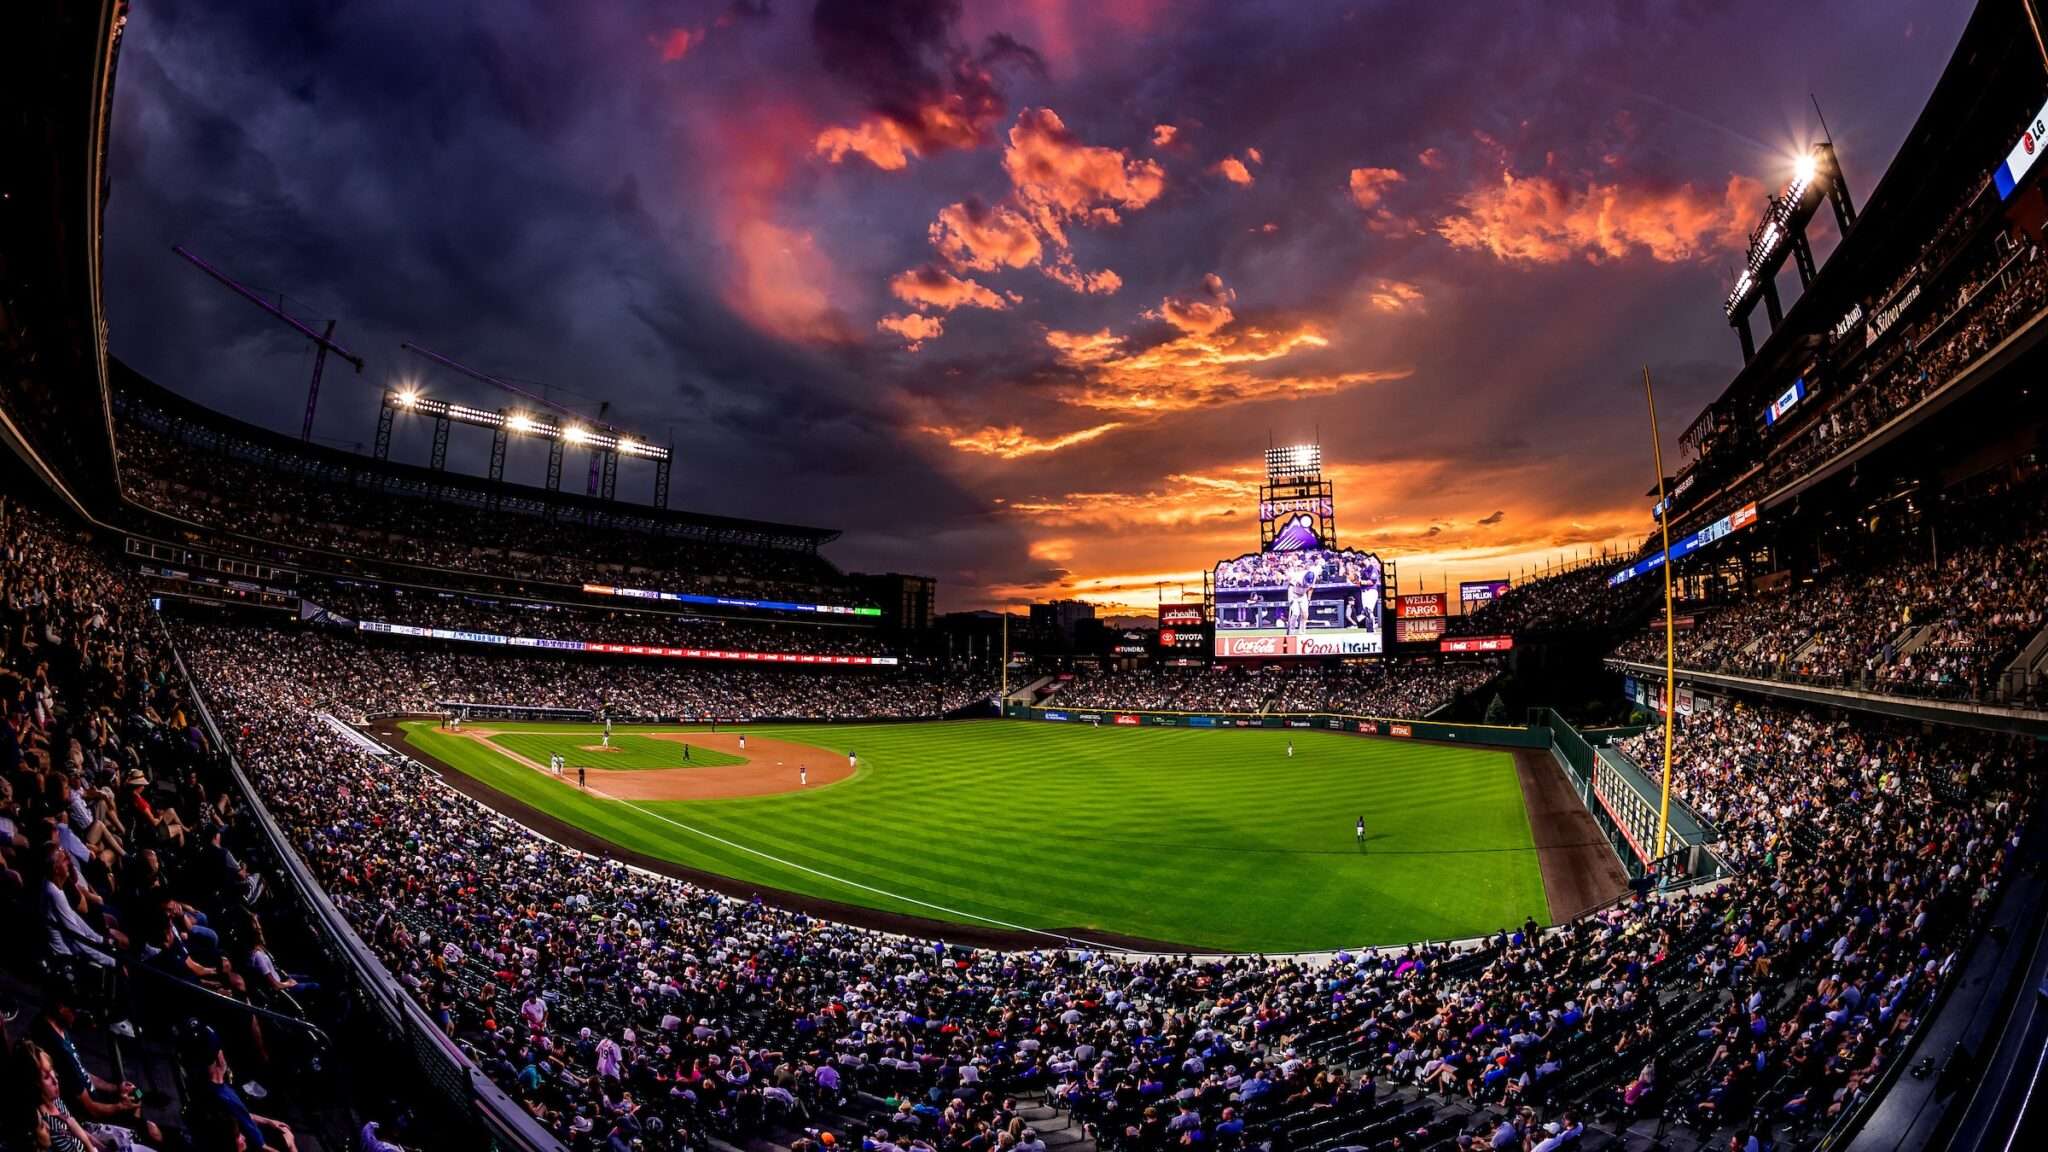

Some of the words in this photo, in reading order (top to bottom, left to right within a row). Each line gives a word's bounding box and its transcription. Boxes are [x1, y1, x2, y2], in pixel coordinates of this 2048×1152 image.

[2032, 119, 2046, 142] LG
[1405, 595, 1437, 605] WELLS
[1405, 605, 1438, 617] FARGO
[1301, 638, 1341, 655] Coors
